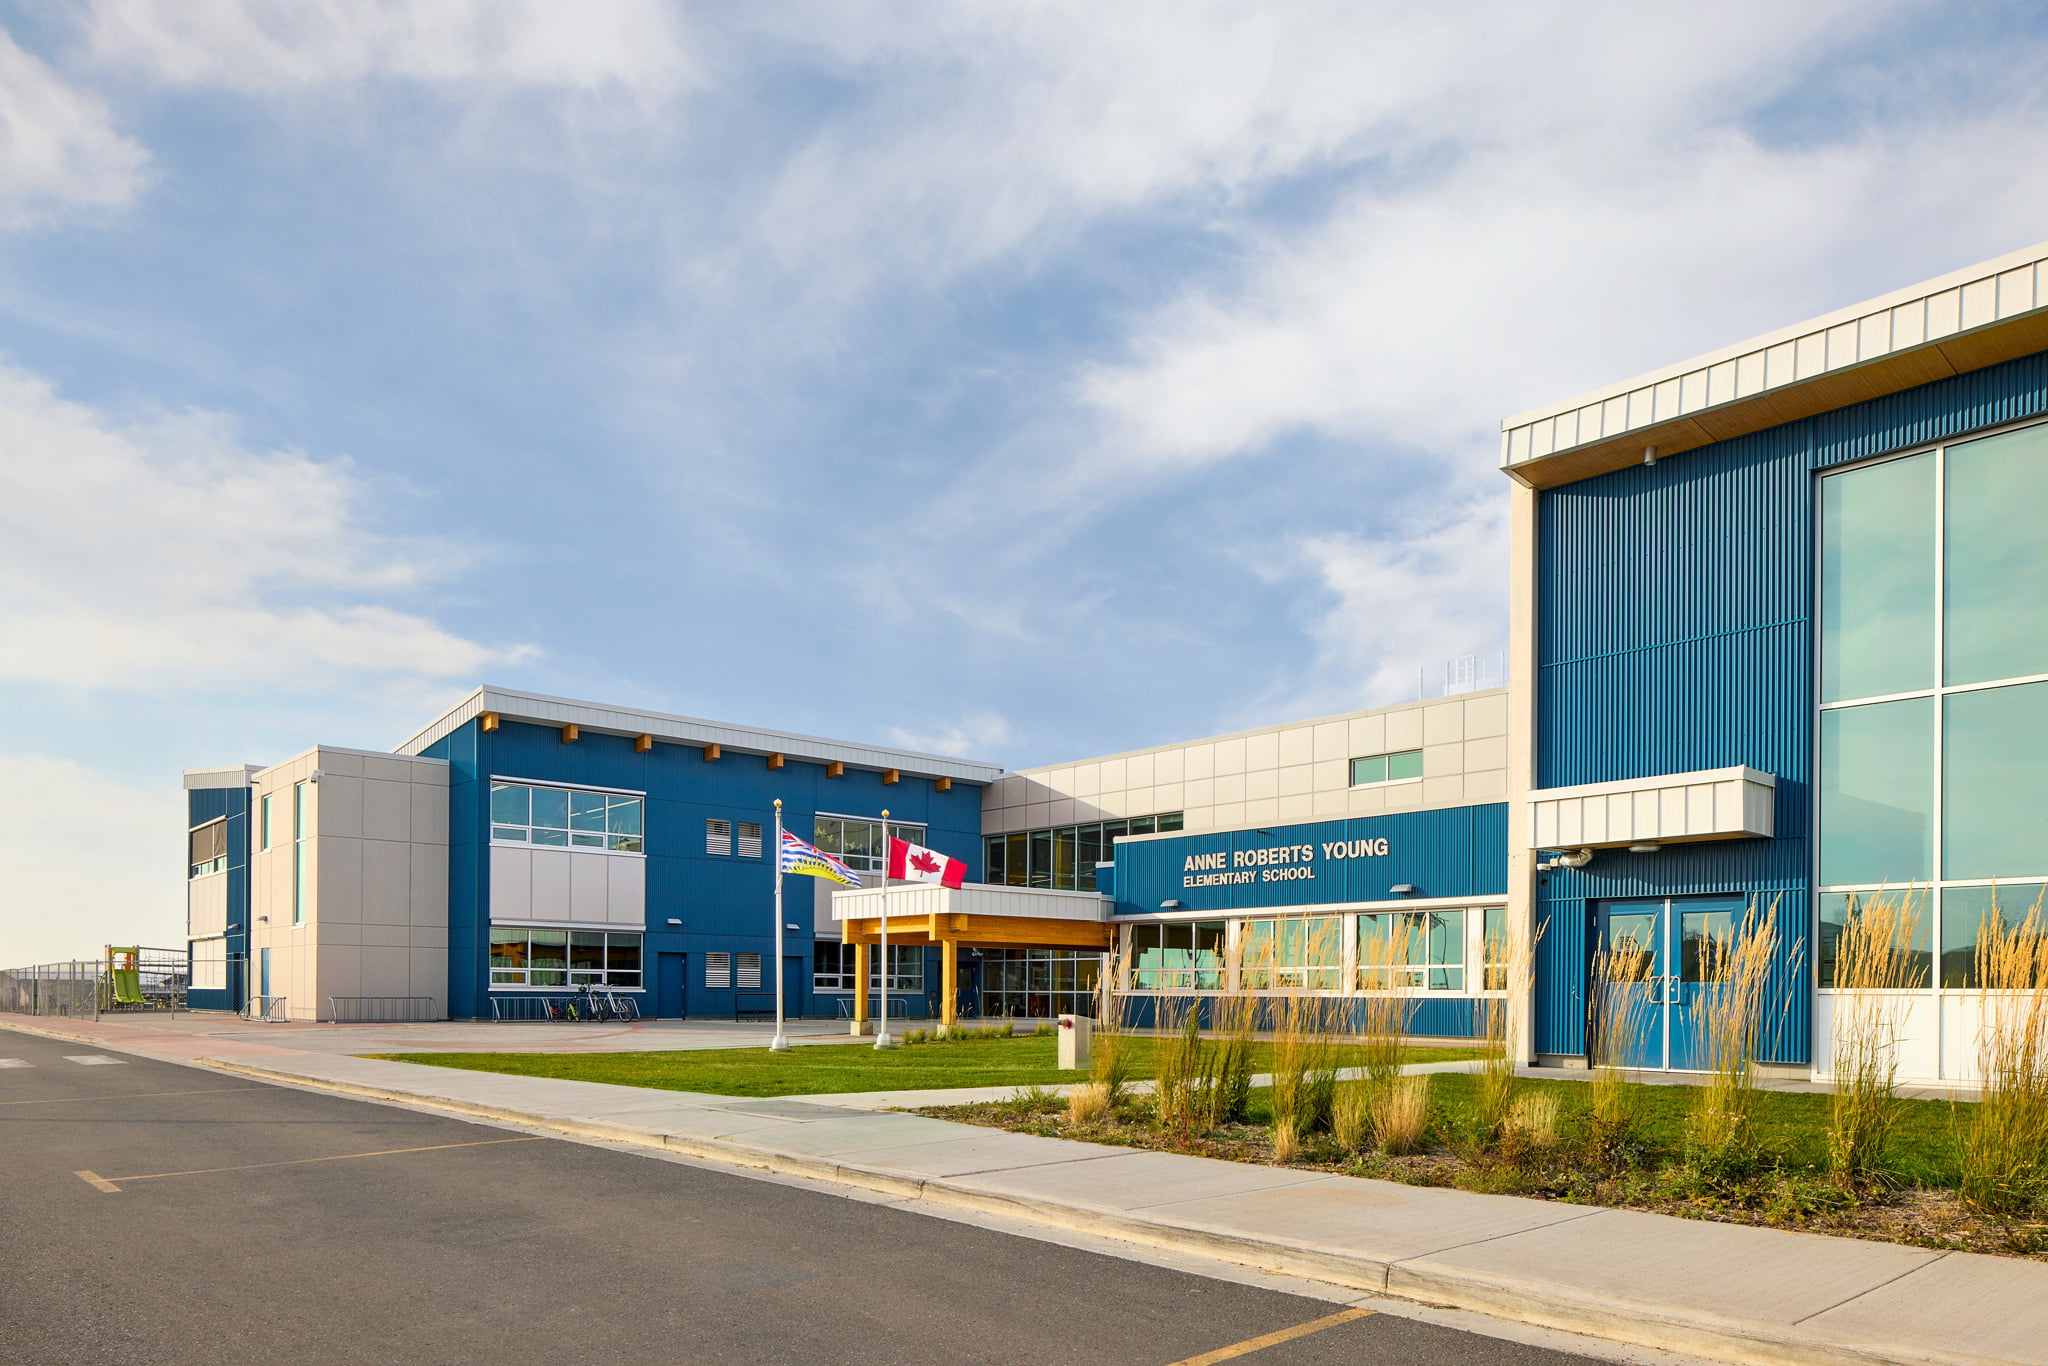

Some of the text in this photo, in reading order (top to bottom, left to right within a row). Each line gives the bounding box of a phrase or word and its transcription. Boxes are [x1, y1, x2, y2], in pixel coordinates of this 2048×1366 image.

[1184, 838, 1389, 872] ANNE ROBERTS YOUNG
[1183, 867, 1316, 888] ELEMENTARY SCHOOL
